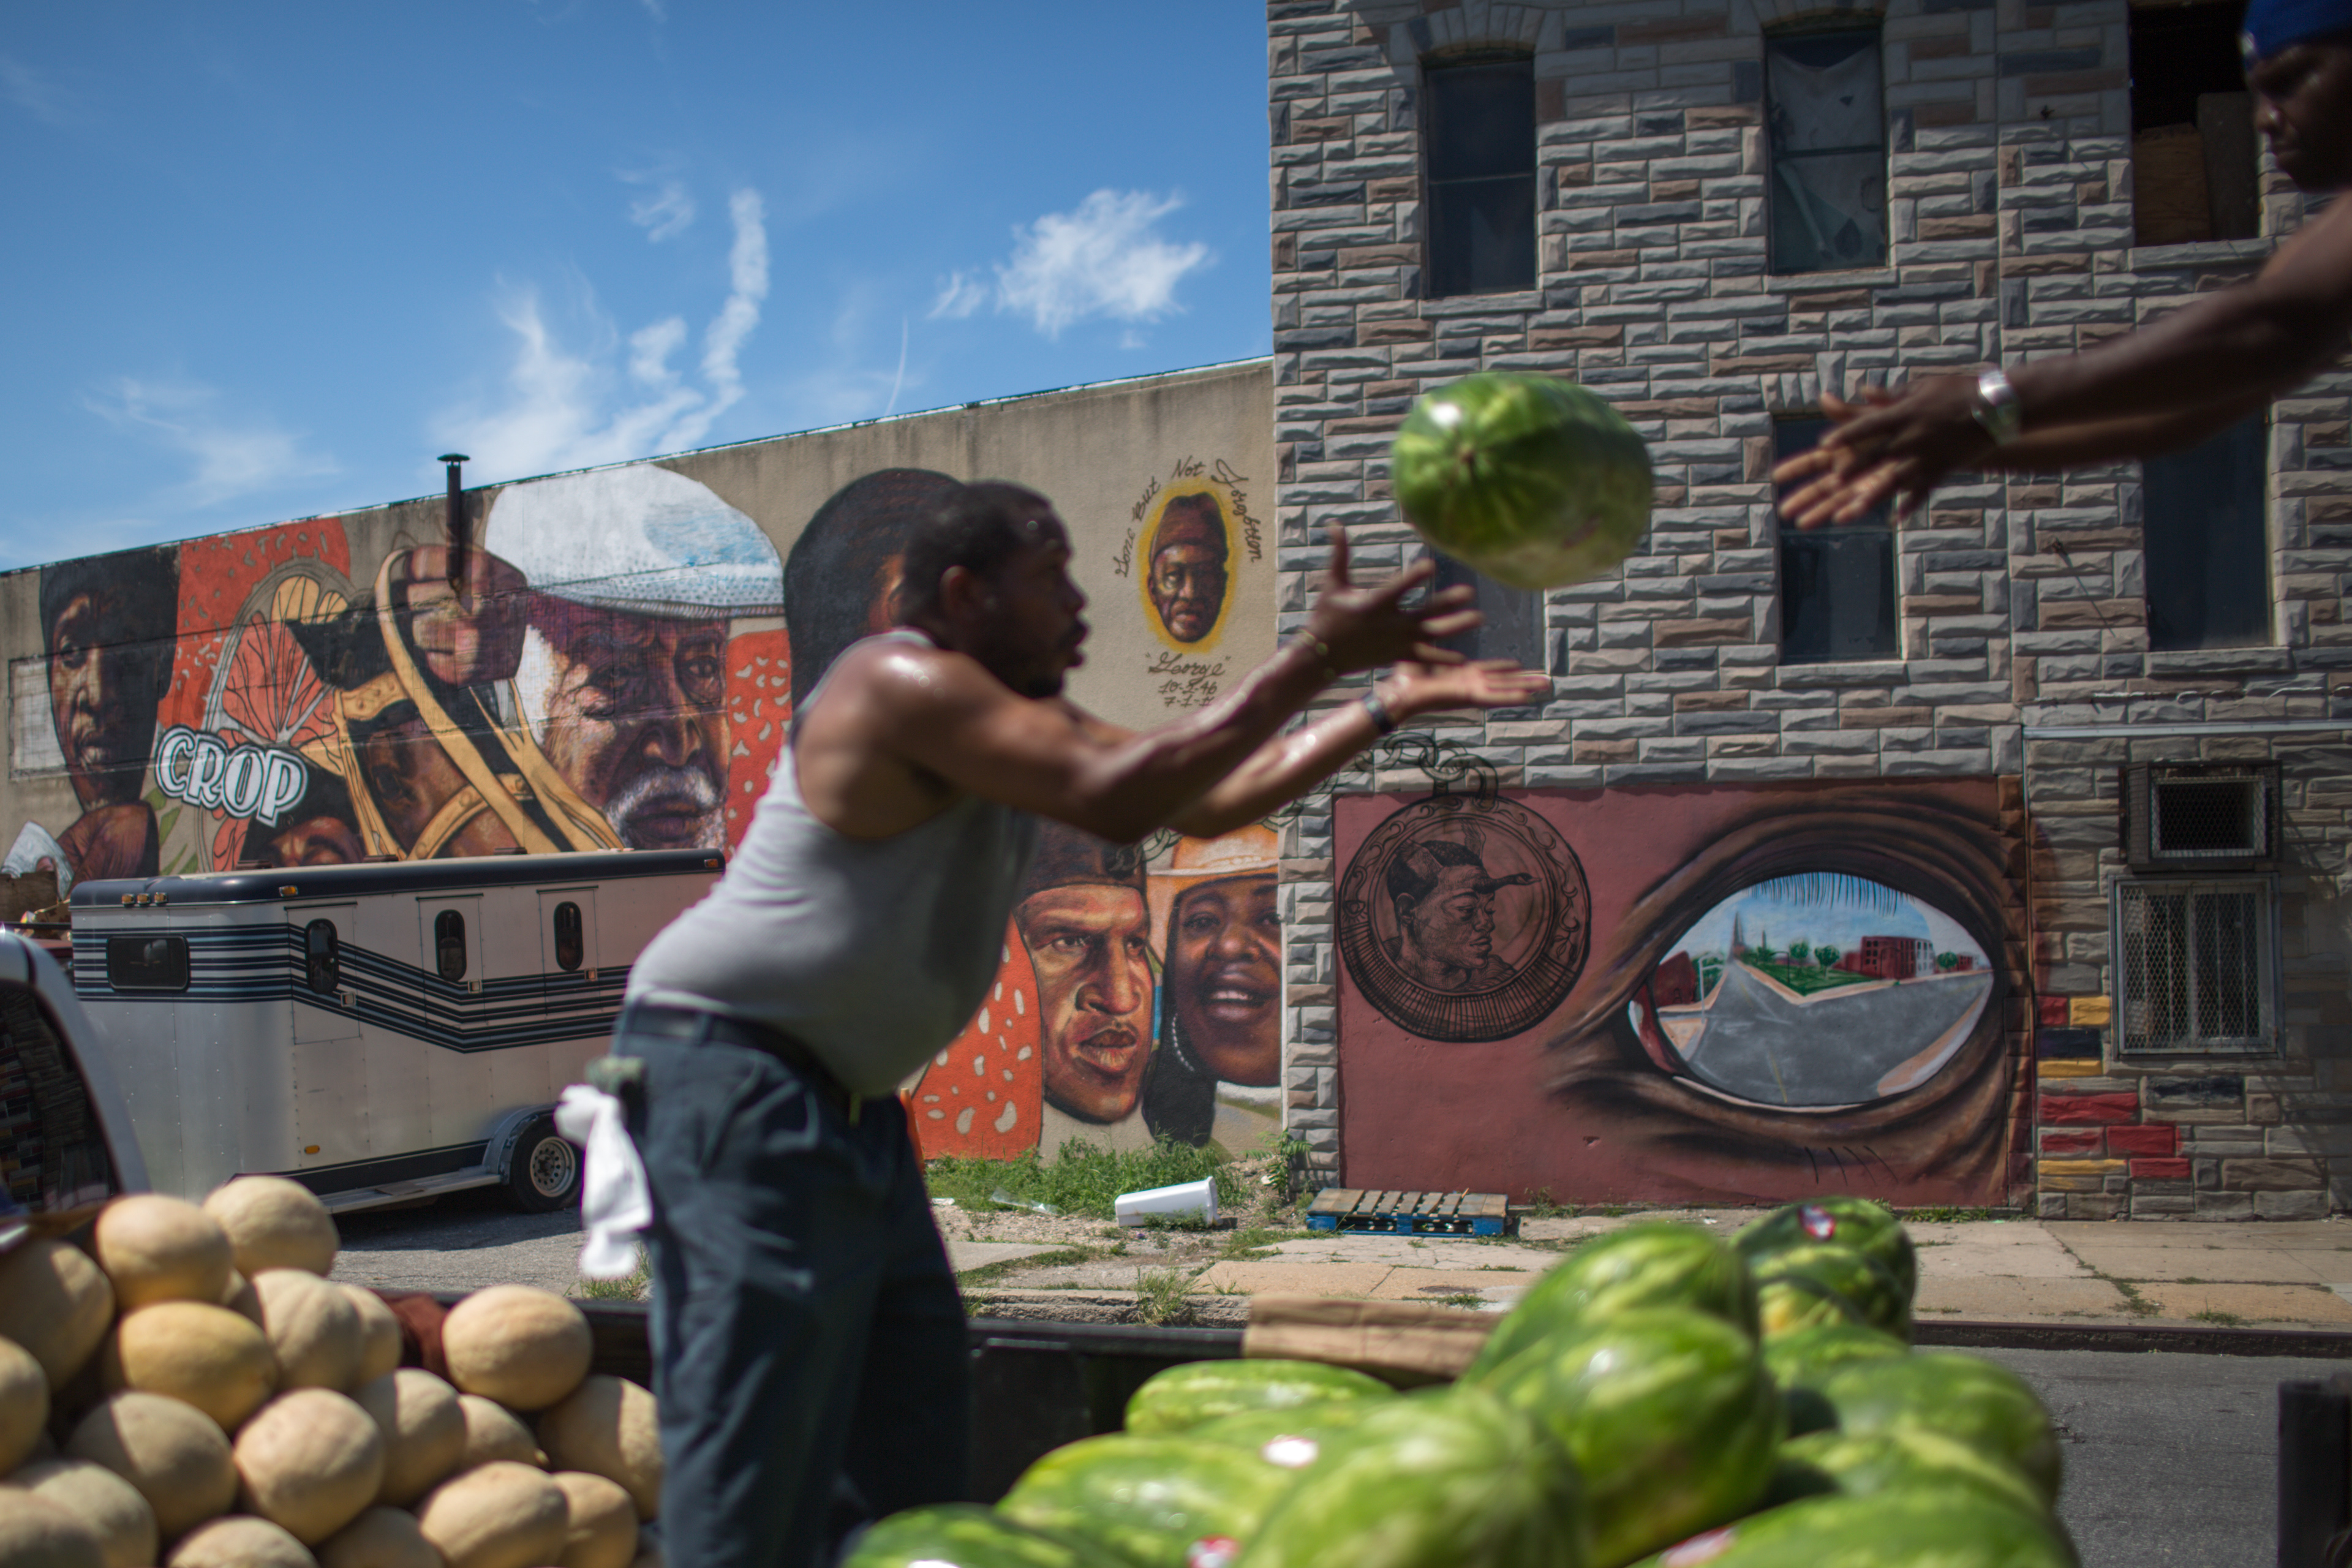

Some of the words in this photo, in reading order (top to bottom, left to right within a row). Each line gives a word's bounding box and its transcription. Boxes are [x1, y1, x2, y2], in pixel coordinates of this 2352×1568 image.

[1133, 476, 1161, 521] But
[1171, 455, 1205, 478] Not
[1210, 459, 1262, 563] Forgotten
[156, 724, 308, 827] CROP
